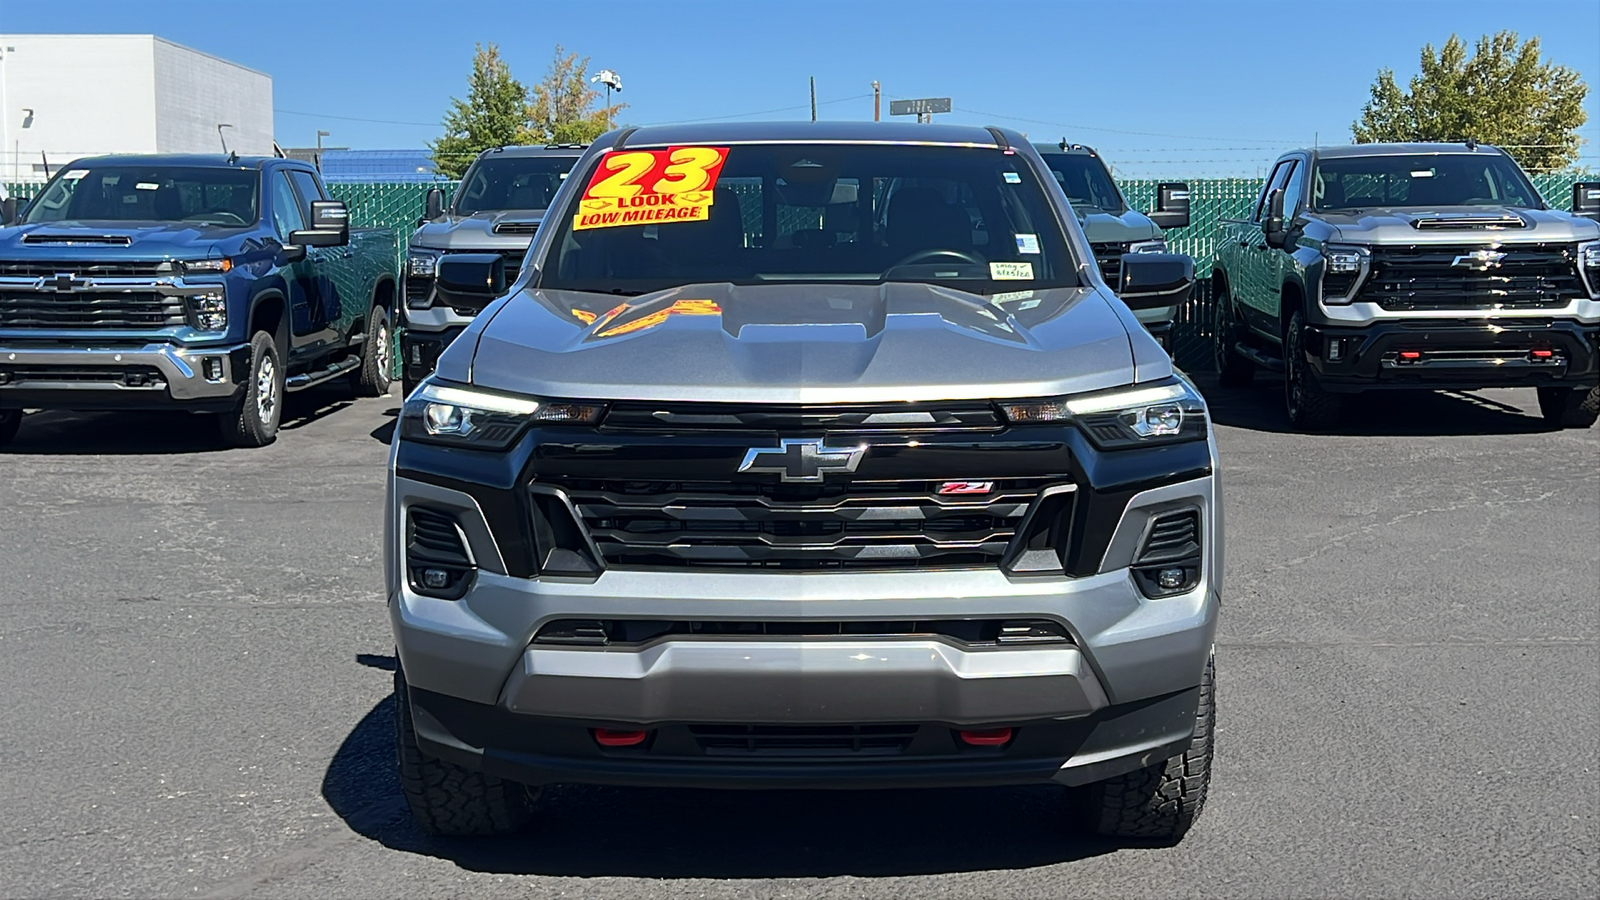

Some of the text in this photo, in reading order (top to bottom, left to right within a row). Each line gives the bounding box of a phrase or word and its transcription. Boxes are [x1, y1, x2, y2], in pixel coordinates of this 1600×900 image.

[588, 147, 723, 198] 23
[617, 193, 678, 208] LOOK
[580, 206, 702, 226] LOW MILEAGE
